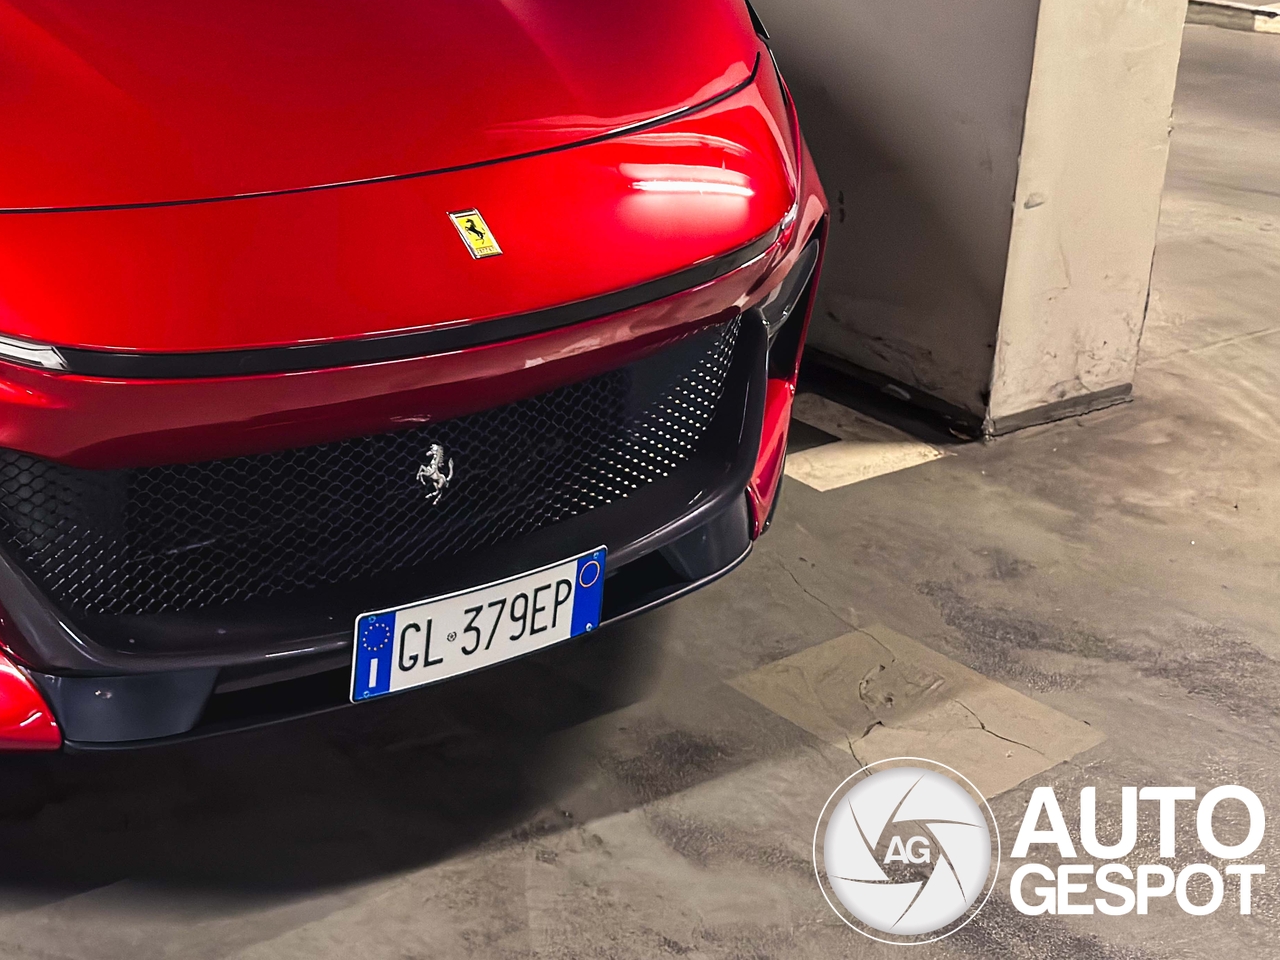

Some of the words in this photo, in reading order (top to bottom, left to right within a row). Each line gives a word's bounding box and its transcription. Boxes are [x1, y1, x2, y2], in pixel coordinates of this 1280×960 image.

[398, 618, 443, 672] GL
[461, 578, 572, 655] 379EP
[368, 658, 378, 688] I
